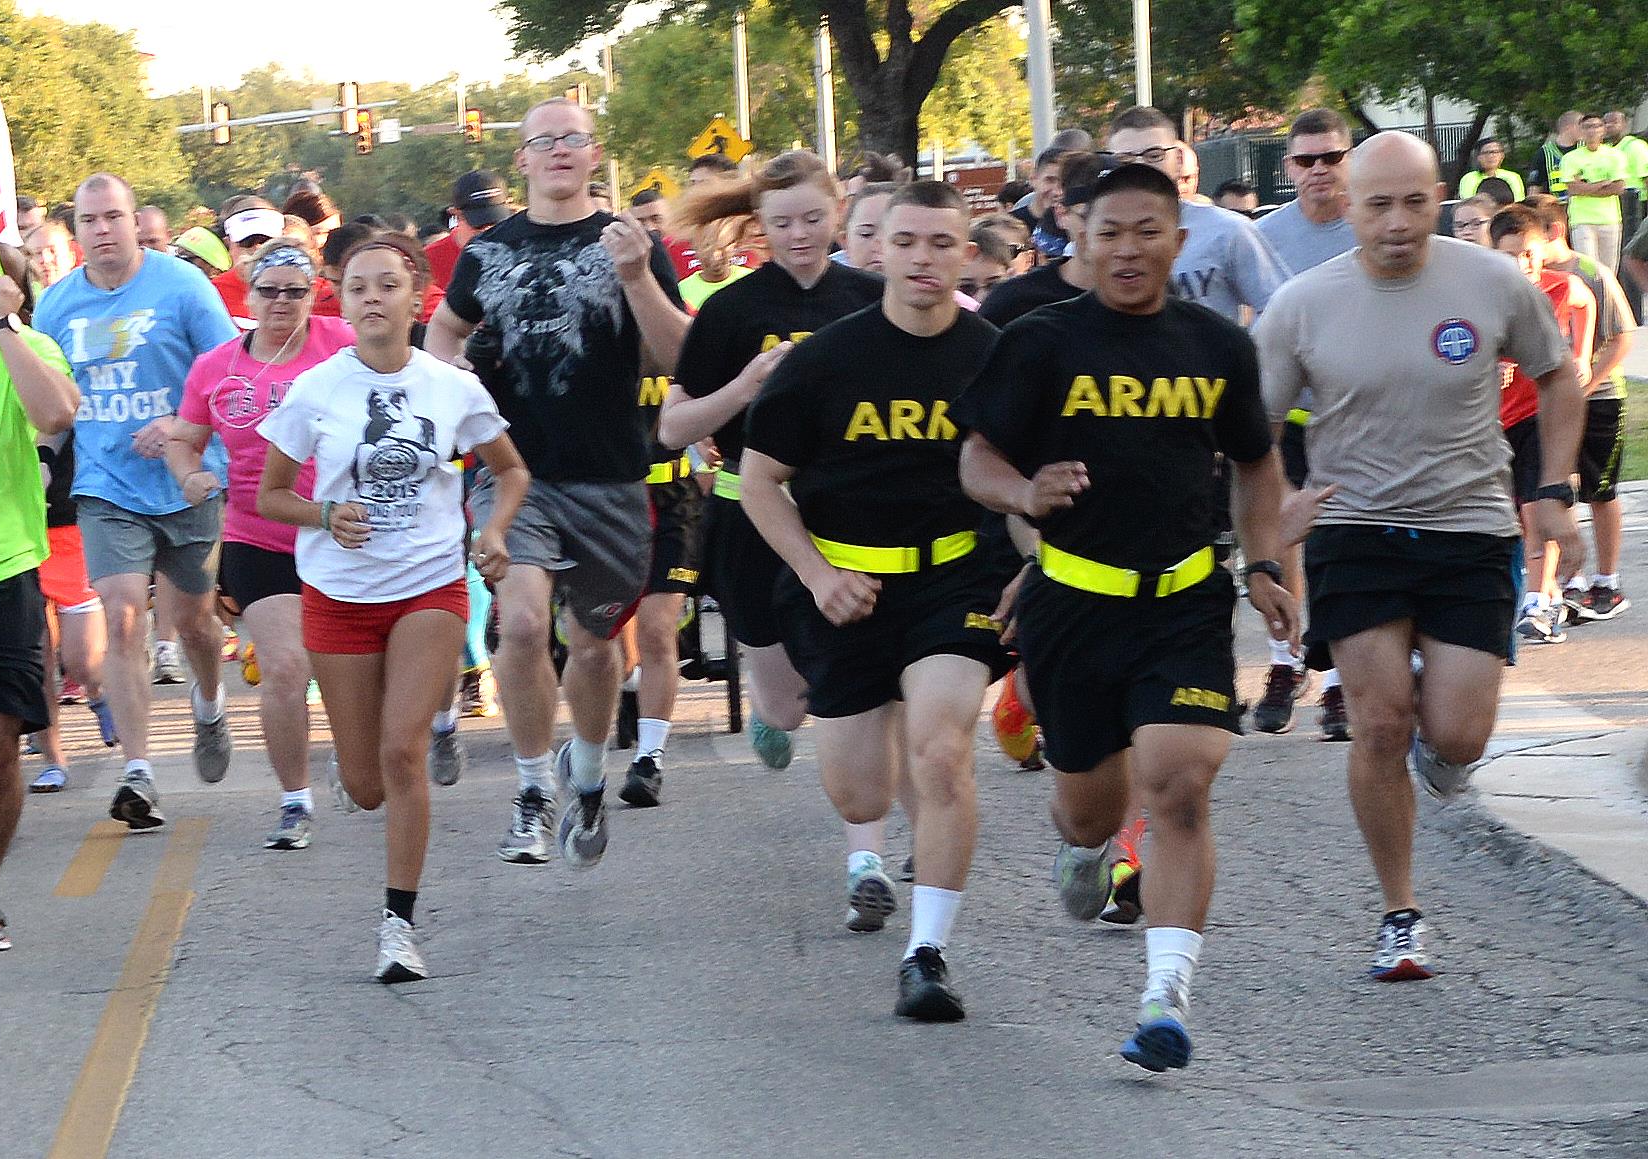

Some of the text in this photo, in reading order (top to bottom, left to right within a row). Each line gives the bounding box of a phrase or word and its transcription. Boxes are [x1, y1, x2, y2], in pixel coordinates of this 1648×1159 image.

[86, 361, 139, 390] MY
[75, 387, 174, 422] BLOCK
[1060, 375, 1227, 420] ARMY
